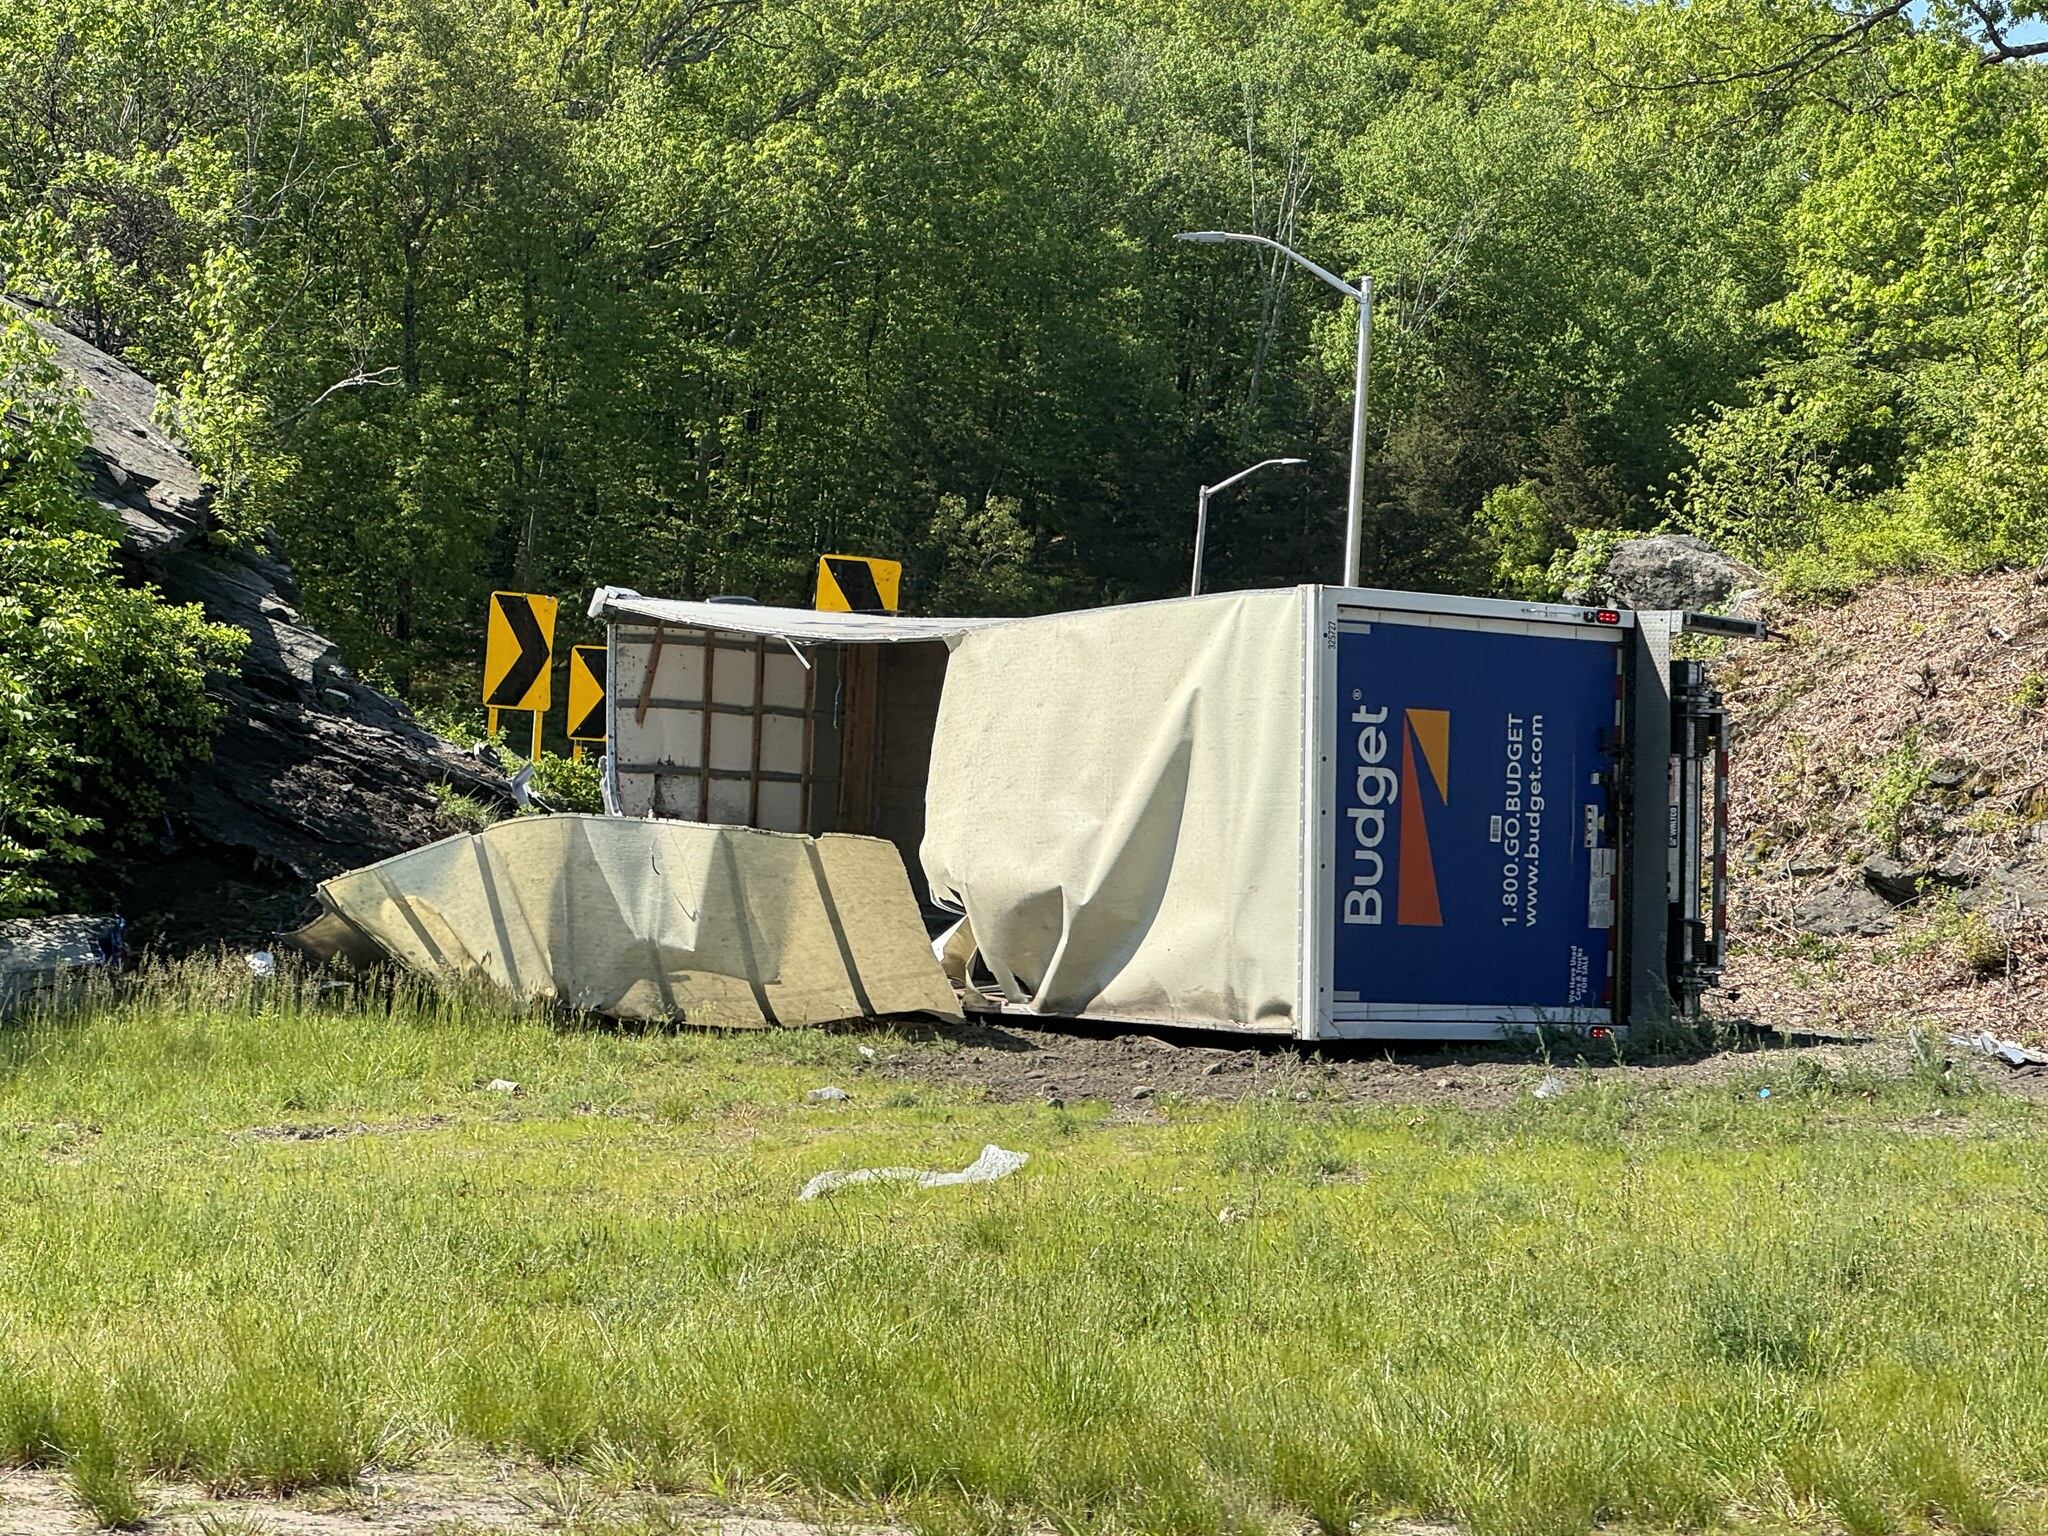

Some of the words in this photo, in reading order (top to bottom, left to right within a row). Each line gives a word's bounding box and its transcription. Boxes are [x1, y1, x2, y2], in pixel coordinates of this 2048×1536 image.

[1501, 713, 1524, 927] 1.800.GO.BUDGET
[1524, 713, 1545, 928] www.budget.com
[1568, 989, 1575, 1003] We
